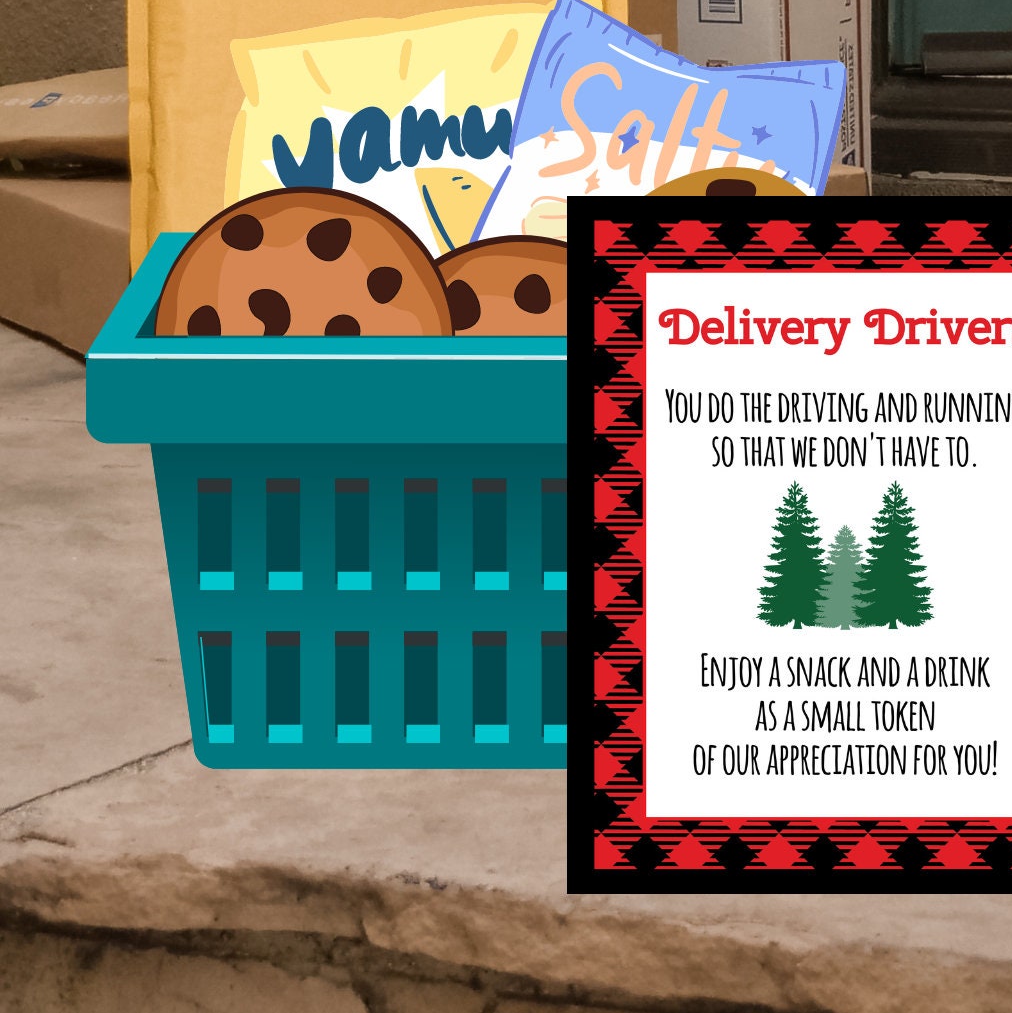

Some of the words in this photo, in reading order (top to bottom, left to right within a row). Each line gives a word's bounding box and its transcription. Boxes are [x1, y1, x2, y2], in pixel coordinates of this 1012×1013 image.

[538, 61, 777, 190] Salt
[659, 306, 851, 355] Delivery
[666, 389, 701, 423] YOU
[709, 392, 733, 423] DO
[740, 393, 772, 423] THE
[779, 392, 868, 423] DRIVING
[875, 393, 917, 422] AND
[712, 436, 734, 467] SO
[741, 436, 785, 466] THAT
[791, 436, 817, 468] WE
[824, 432, 885, 467] DON'T
[893, 436, 939, 467] HAVE
[946, 436, 976, 467] TO.
[701, 653, 762, 690] ENJOY
[769, 657, 780, 687] A
[787, 657, 851, 687] SNACK
[858, 657, 900, 687] AND
[907, 657, 918, 687] A
[925, 657, 990, 687] DRINK
[755, 701, 776, 731] AS
[784, 701, 795, 731] A
[802, 701, 865, 733] SMALL
[871, 701, 934, 731] TOKEN
[694, 745, 716, 775] OF
[723, 744, 760, 775] OUR
[767, 745, 906, 775] APPRECIATION
[914, 745, 947, 775] FOR
[954, 740, 997, 775] YOU!
